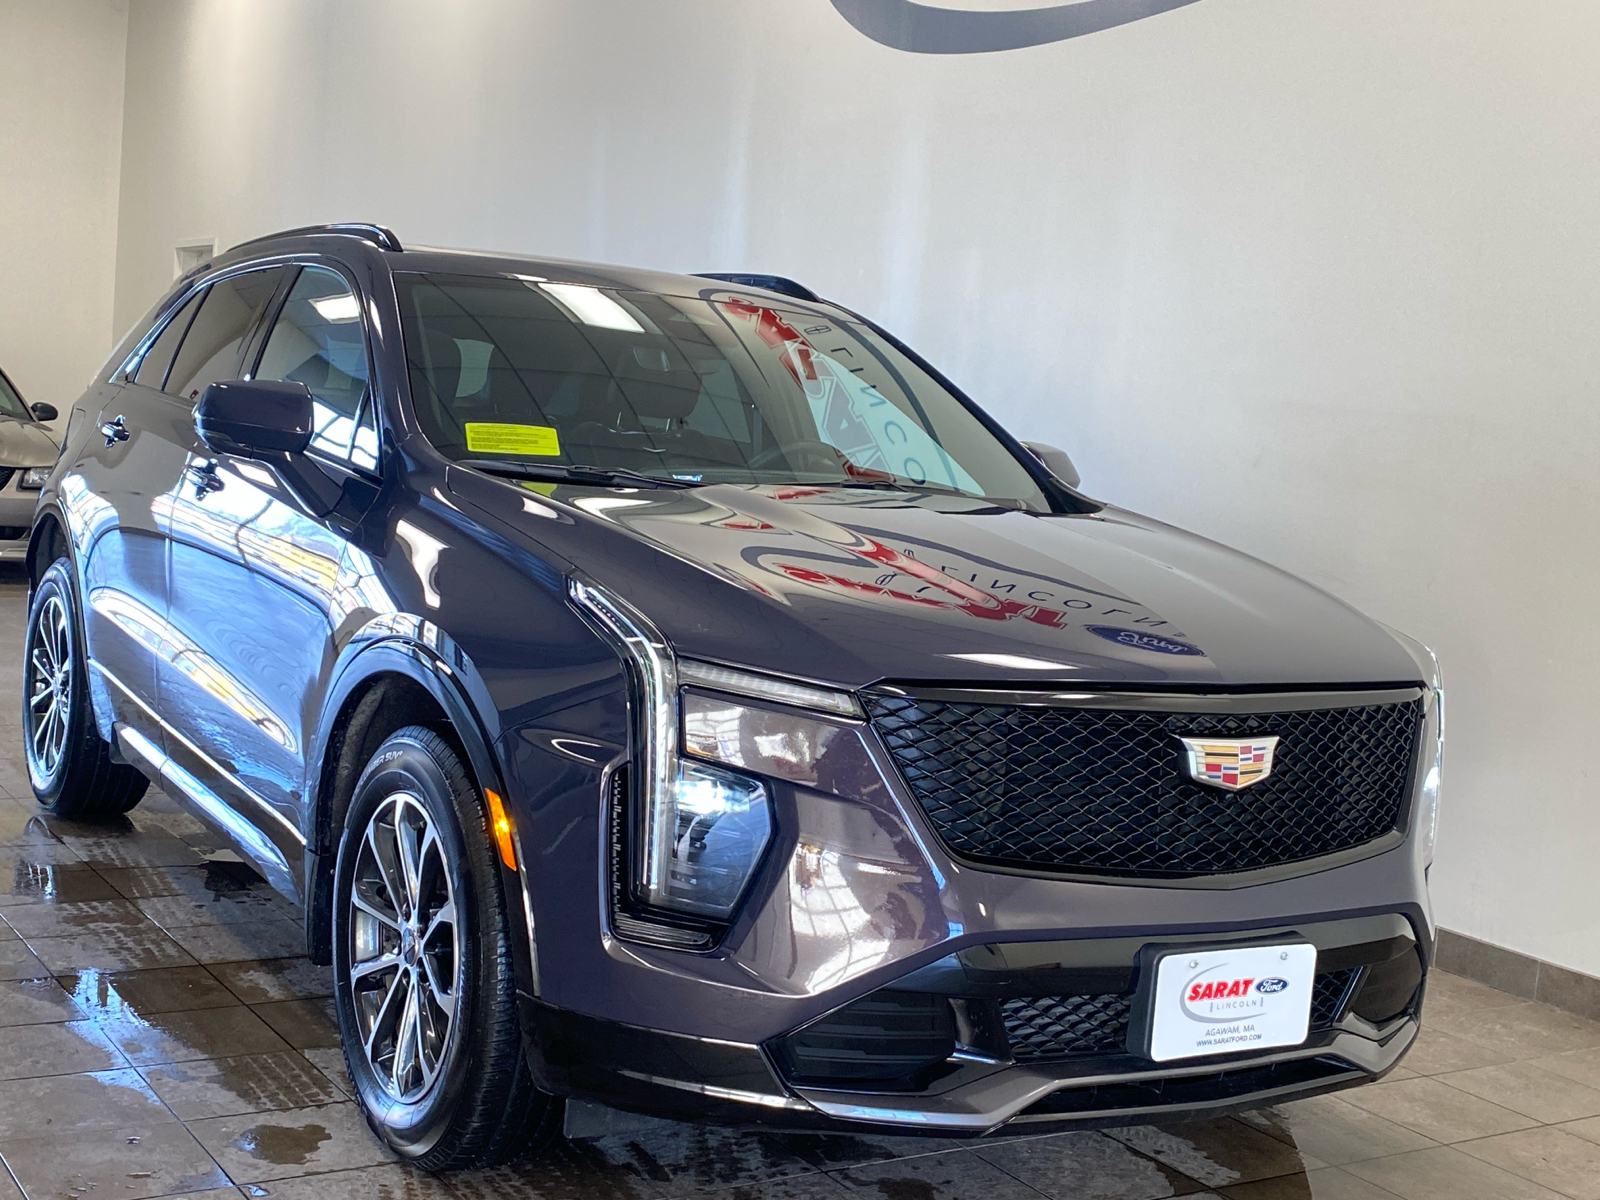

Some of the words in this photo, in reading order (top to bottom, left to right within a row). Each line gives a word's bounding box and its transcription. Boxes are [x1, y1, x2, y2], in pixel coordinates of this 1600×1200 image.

[1187, 977, 1256, 1003] SARAT
[1259, 978, 1286, 993] Ford
[1216, 999, 1258, 1011] LINCOLN
[1205, 1025, 1241, 1037] AGAWAM,
[1243, 1024, 1256, 1033] MA
